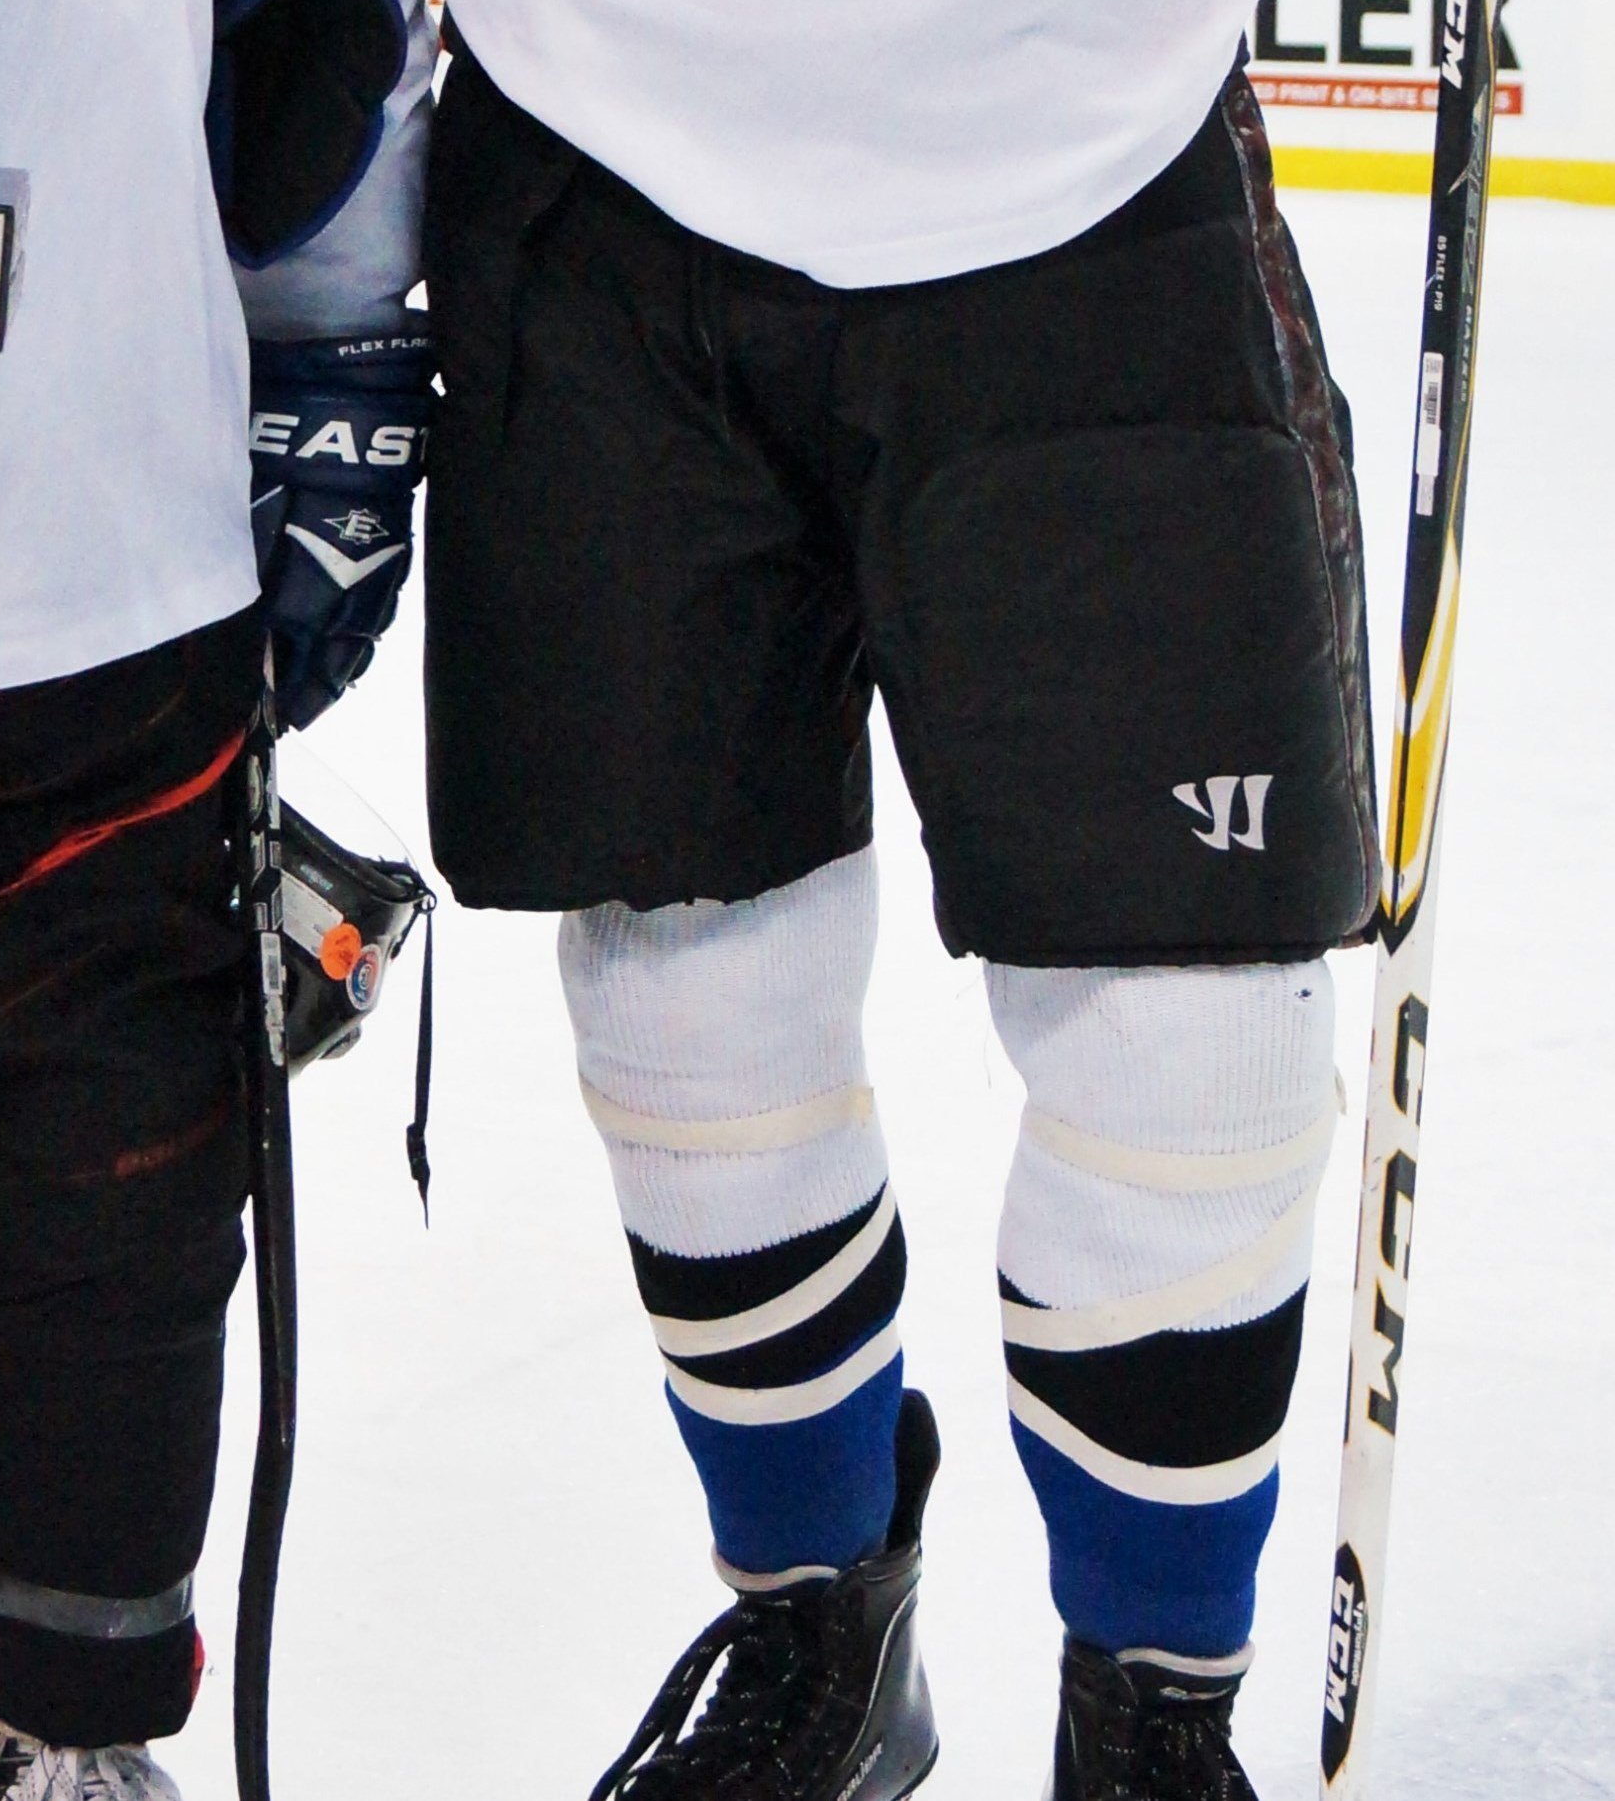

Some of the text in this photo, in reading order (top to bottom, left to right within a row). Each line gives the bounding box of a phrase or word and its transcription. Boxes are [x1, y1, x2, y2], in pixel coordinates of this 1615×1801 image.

[1434, 252, 1446, 281] FLEX
[338, 339, 384, 357] FLEX
[250, 411, 429, 466] EAS
[1326, 1574, 1355, 1724] CCM
